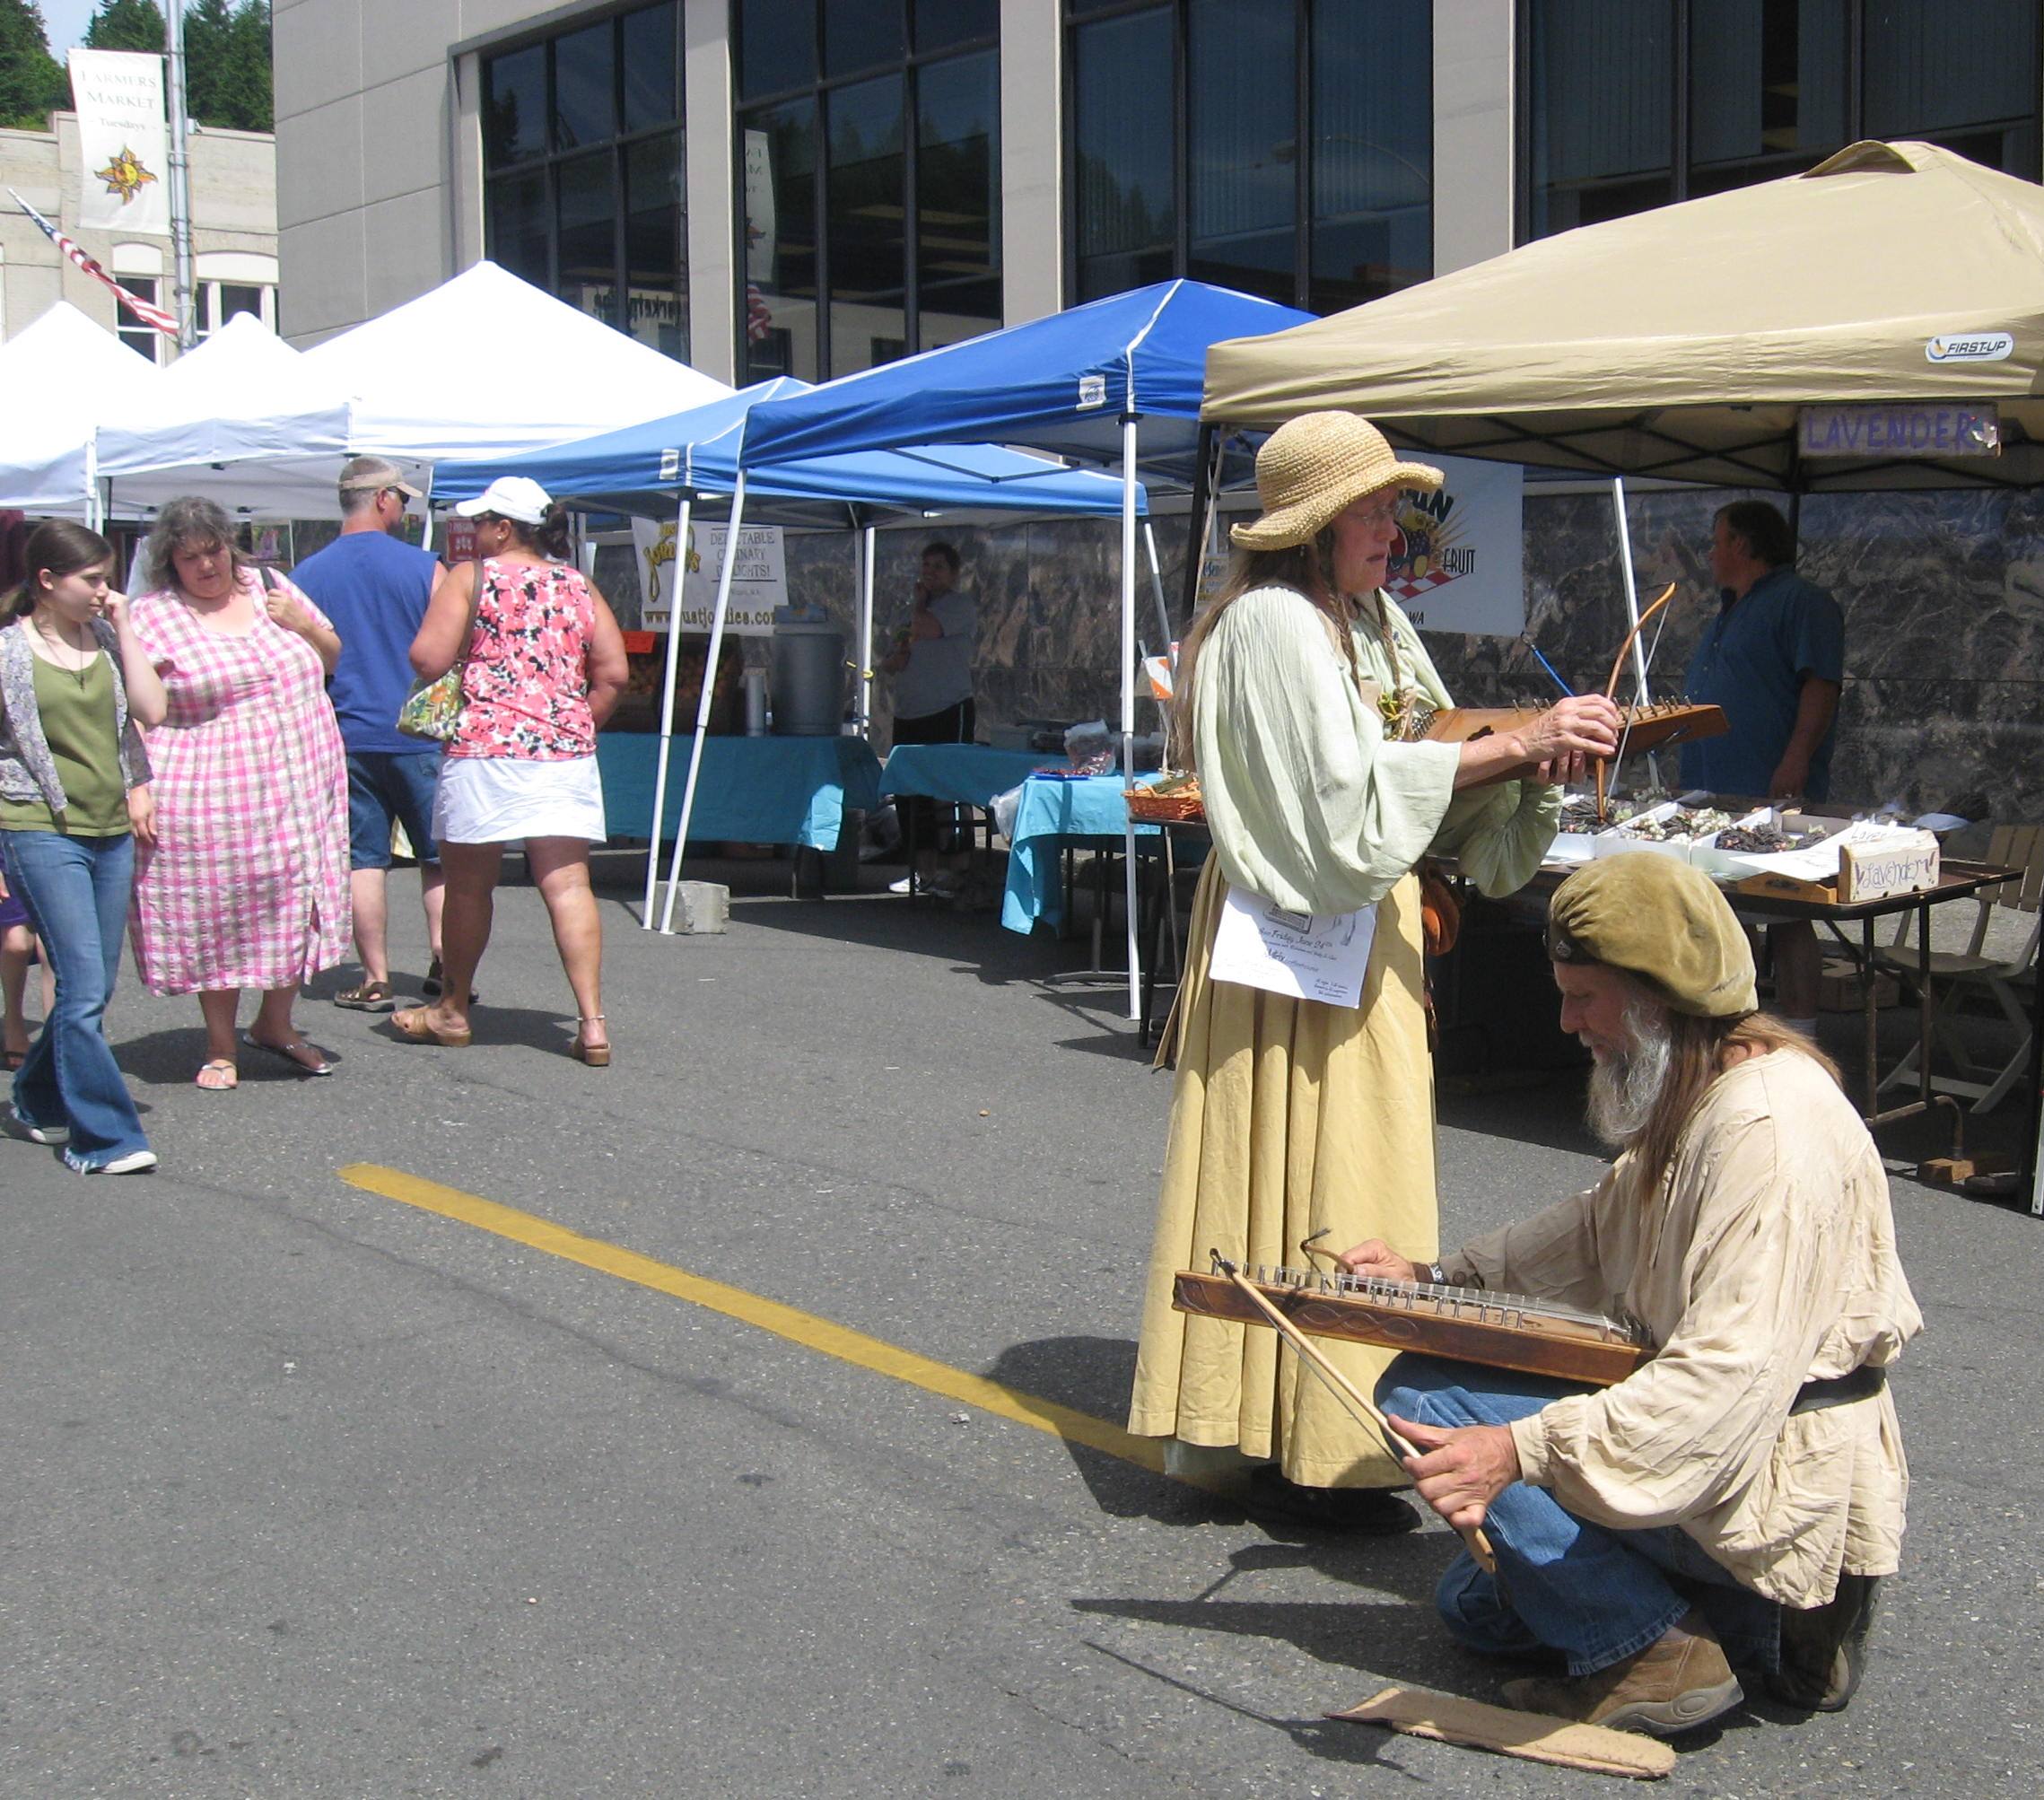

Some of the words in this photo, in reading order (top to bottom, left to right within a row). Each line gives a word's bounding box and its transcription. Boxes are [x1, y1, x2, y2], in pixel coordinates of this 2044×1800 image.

[87, 92, 155, 109] MARKET
[1807, 410, 1980, 451] LAVENDER
[1442, 549, 1476, 573] FRUIT
[1409, 611, 1425, 625] WA
